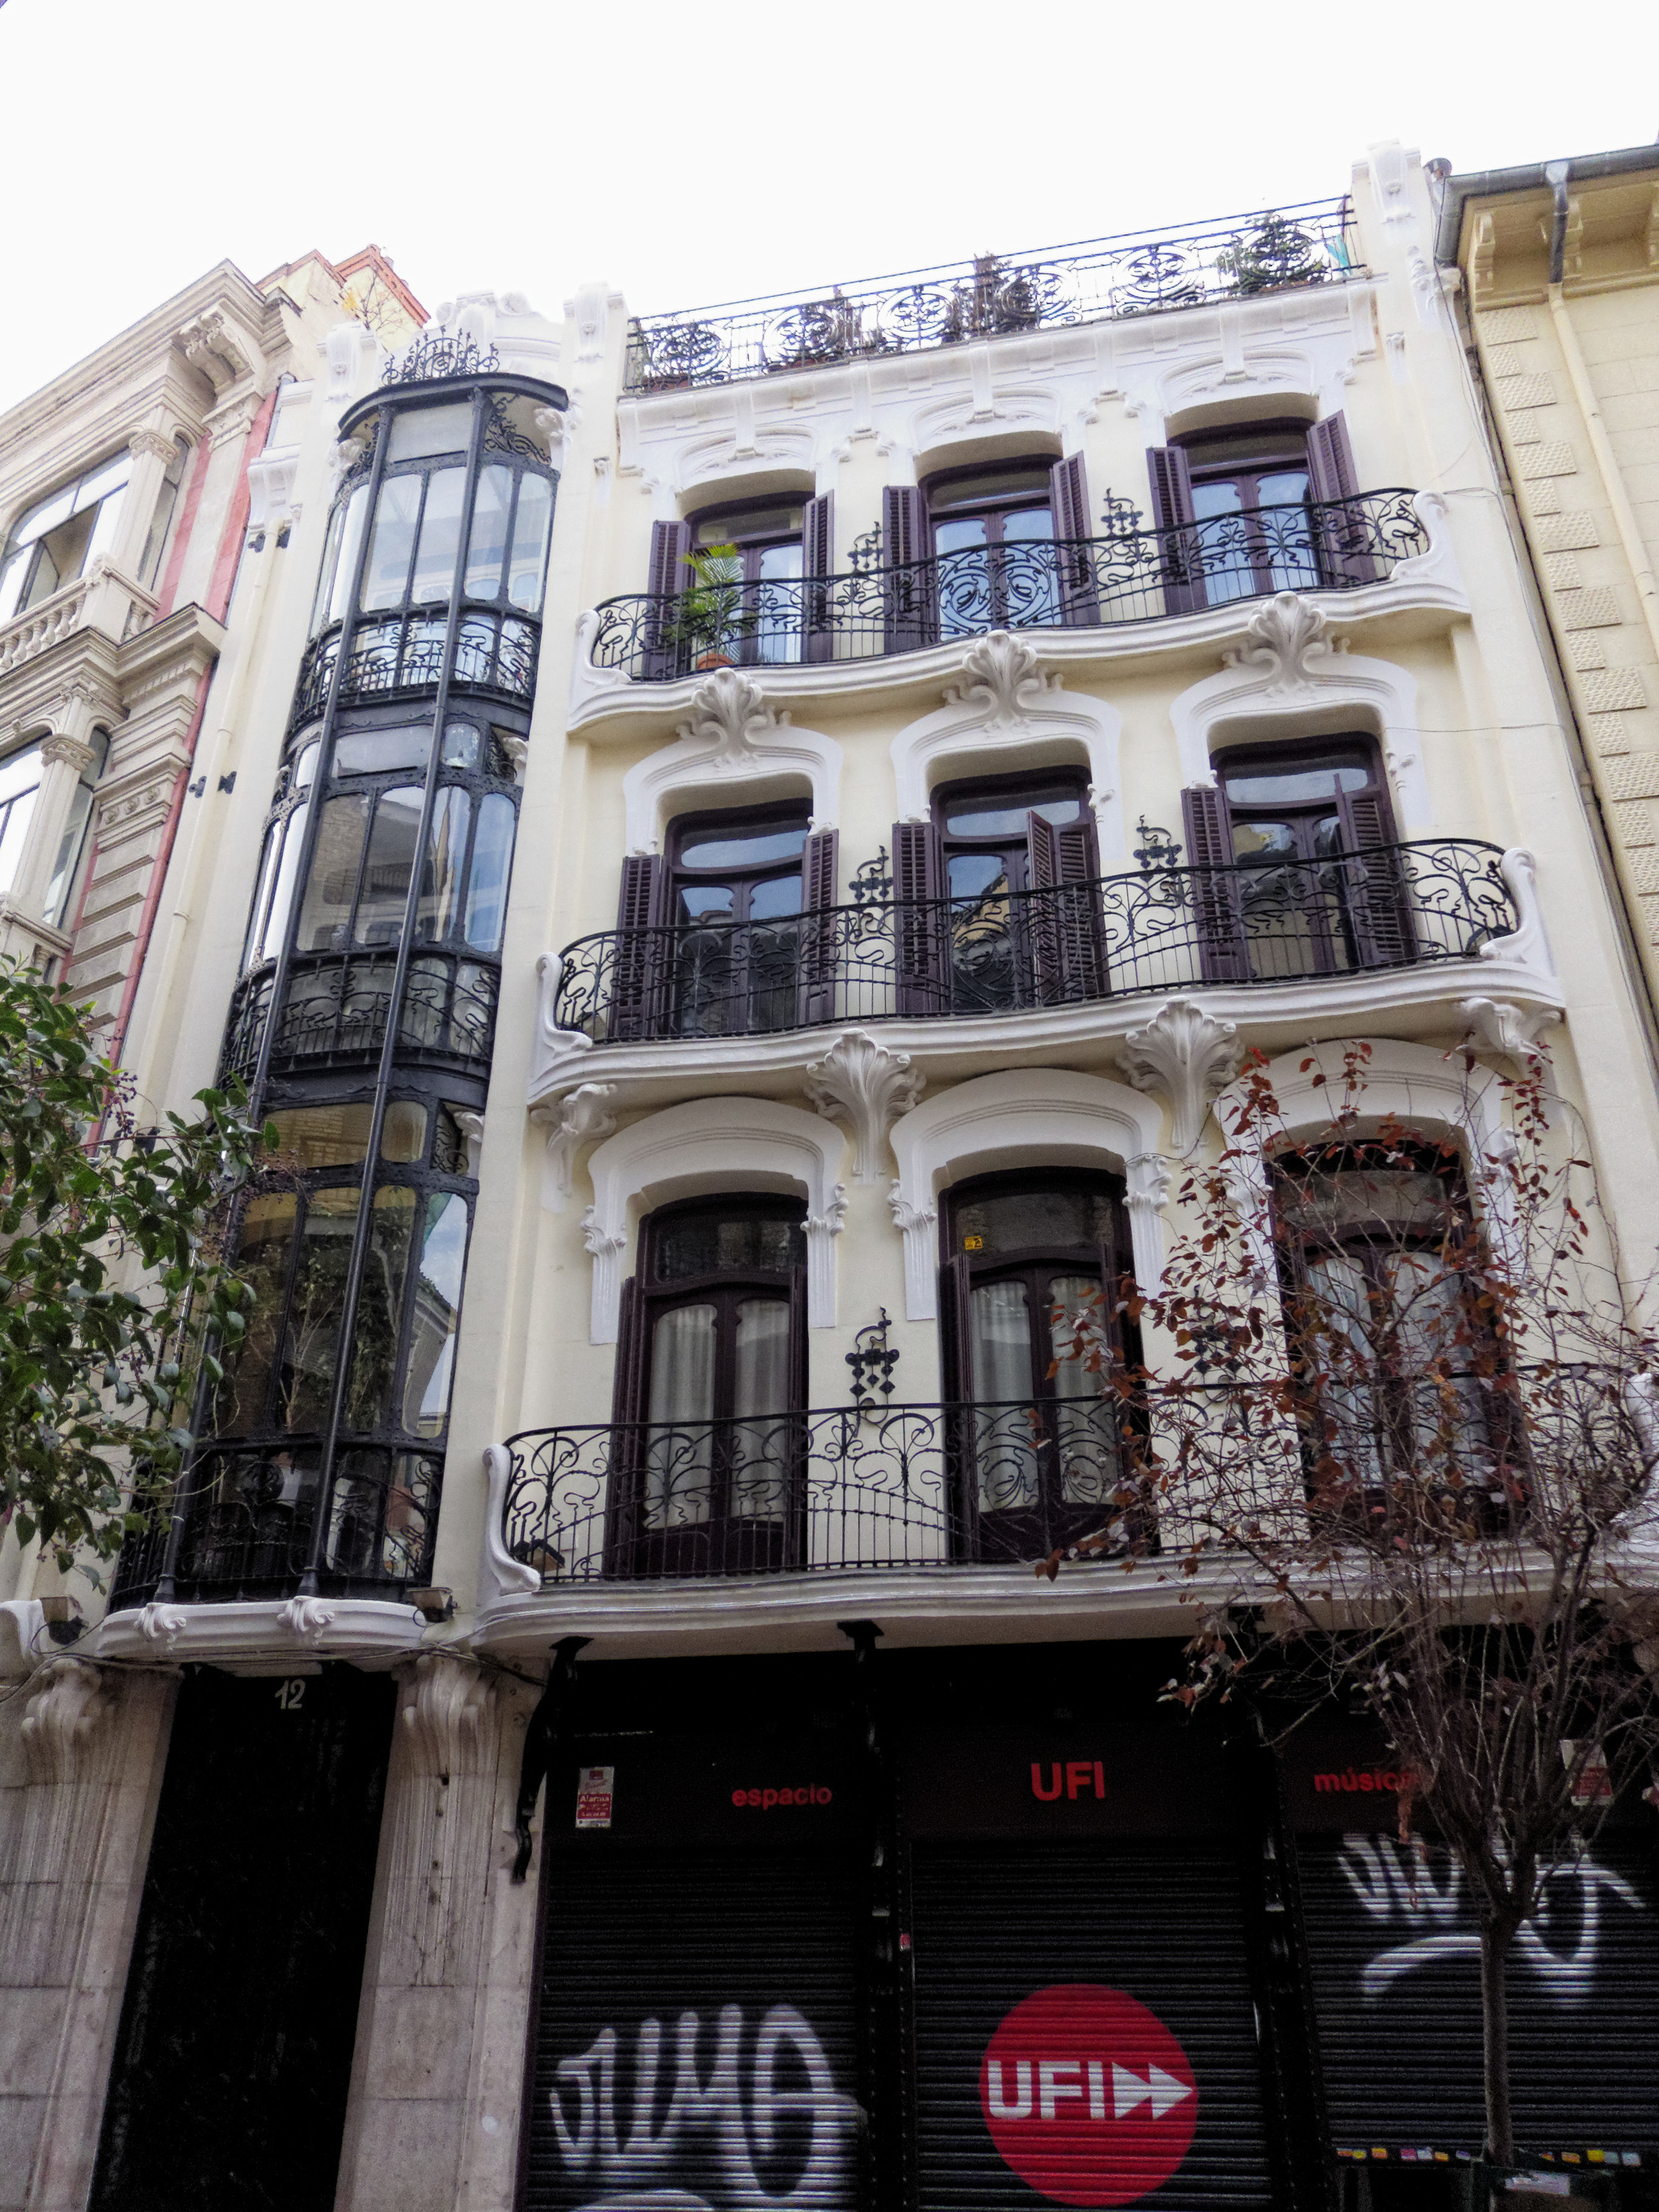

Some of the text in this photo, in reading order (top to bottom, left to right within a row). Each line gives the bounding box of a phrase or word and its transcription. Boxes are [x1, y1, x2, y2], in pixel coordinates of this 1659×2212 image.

[275, 1678, 305, 1710] 12
[731, 1783, 832, 1810] espacio
[1031, 1761, 1105, 1801] UFI
[580, 1795, 610, 1803] Alarma
[987, 2060, 1105, 2120] UFI
